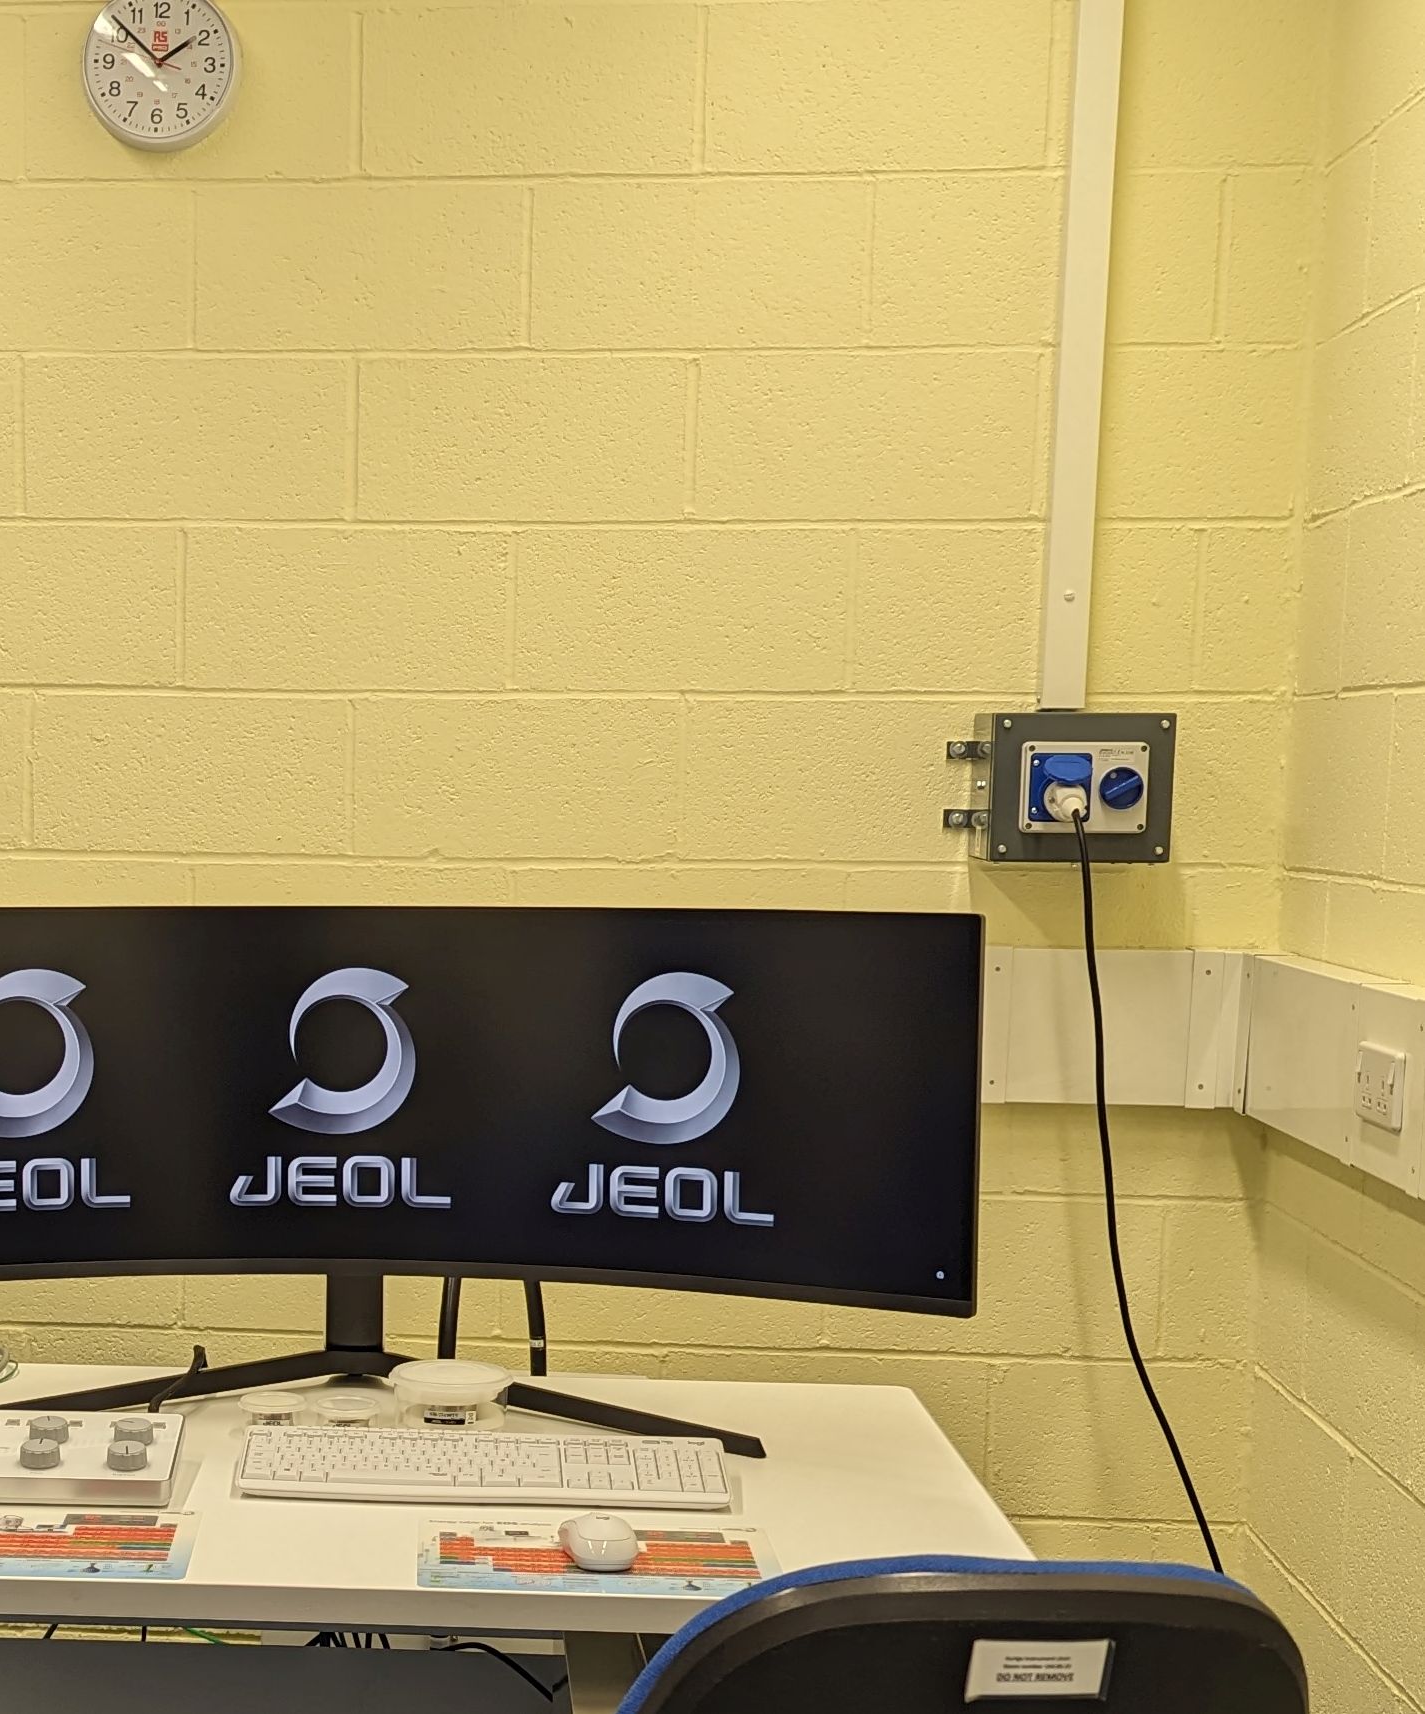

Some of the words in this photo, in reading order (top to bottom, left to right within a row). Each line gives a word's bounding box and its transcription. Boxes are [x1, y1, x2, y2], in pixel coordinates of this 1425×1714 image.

[131, 7, 143, 24] 11
[153, 2, 171, 19] 12
[184, 9, 190, 26] 1
[111, 26, 128, 43] 10
[153, 31, 168, 43] RS
[197, 29, 210, 46] 2
[102, 53, 115, 70] 9
[203, 57, 216, 73] 3
[108, 80, 121, 97] 8
[194, 83, 207, 100] 4
[126, 101, 138, 117] 7
[150, 108, 163, 124] 6
[175, 103, 188, 119] 5
[230, 1154, 451, 1209] JEOL
[550, 1163, 774, 1227] JEOL
[996, 1673, 1011, 1682] DO
[1013, 1673, 1033, 1682] NOT
[1034, 1673, 1075, 1682] REMOVE
